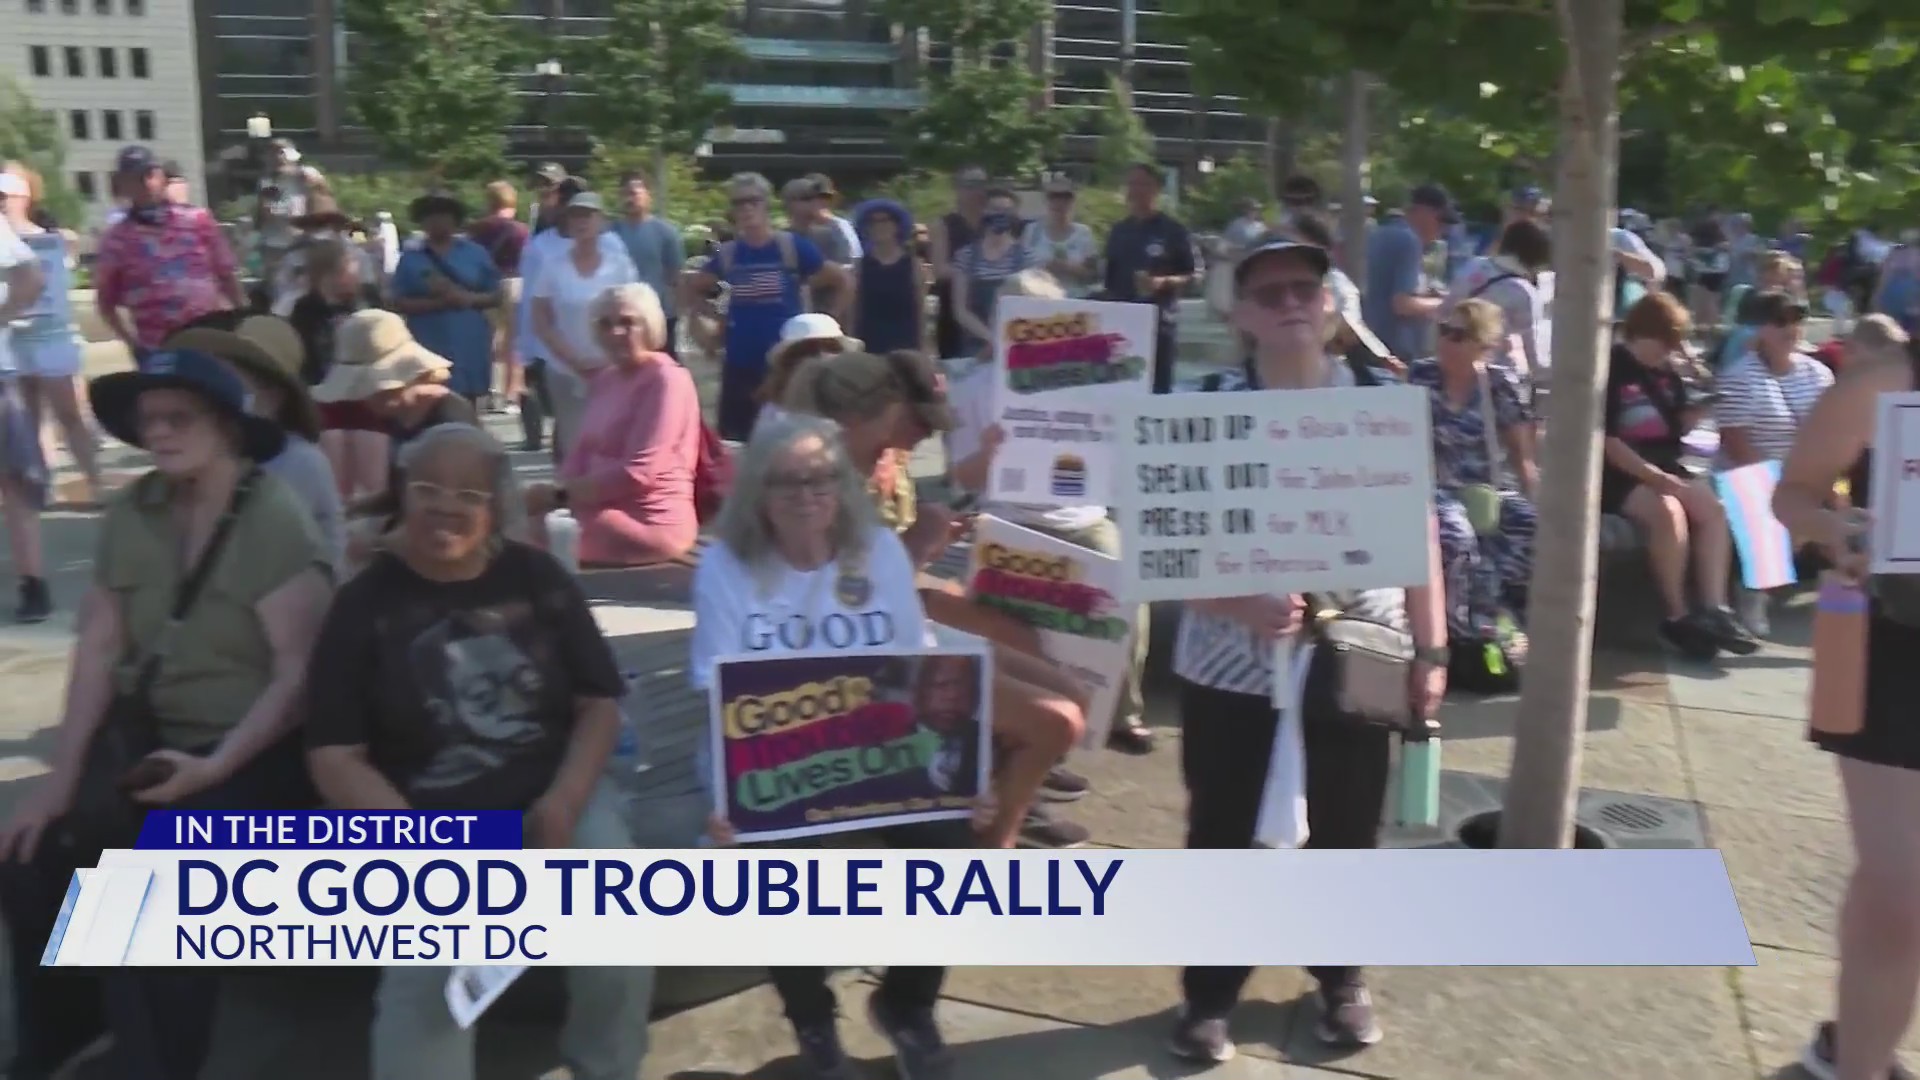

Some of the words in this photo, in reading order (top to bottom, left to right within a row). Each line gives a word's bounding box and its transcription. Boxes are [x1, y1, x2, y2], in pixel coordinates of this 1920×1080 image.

[1009, 312, 1087, 342] Good
[1134, 415, 1217, 445] STAND
[1223, 414, 1257, 440] UP
[1136, 463, 1212, 494] SPEAK
[1223, 462, 1270, 491] OUT
[1138, 507, 1210, 537] PRESS
[1222, 508, 1256, 534] ON
[1305, 510, 1354, 537] MLK
[982, 543, 1069, 580] Good
[1139, 549, 1200, 580] FIGHT
[742, 610, 894, 651] GOOD
[736, 677, 847, 733] Good
[749, 757, 851, 804] Lives
[861, 743, 919, 776] On
